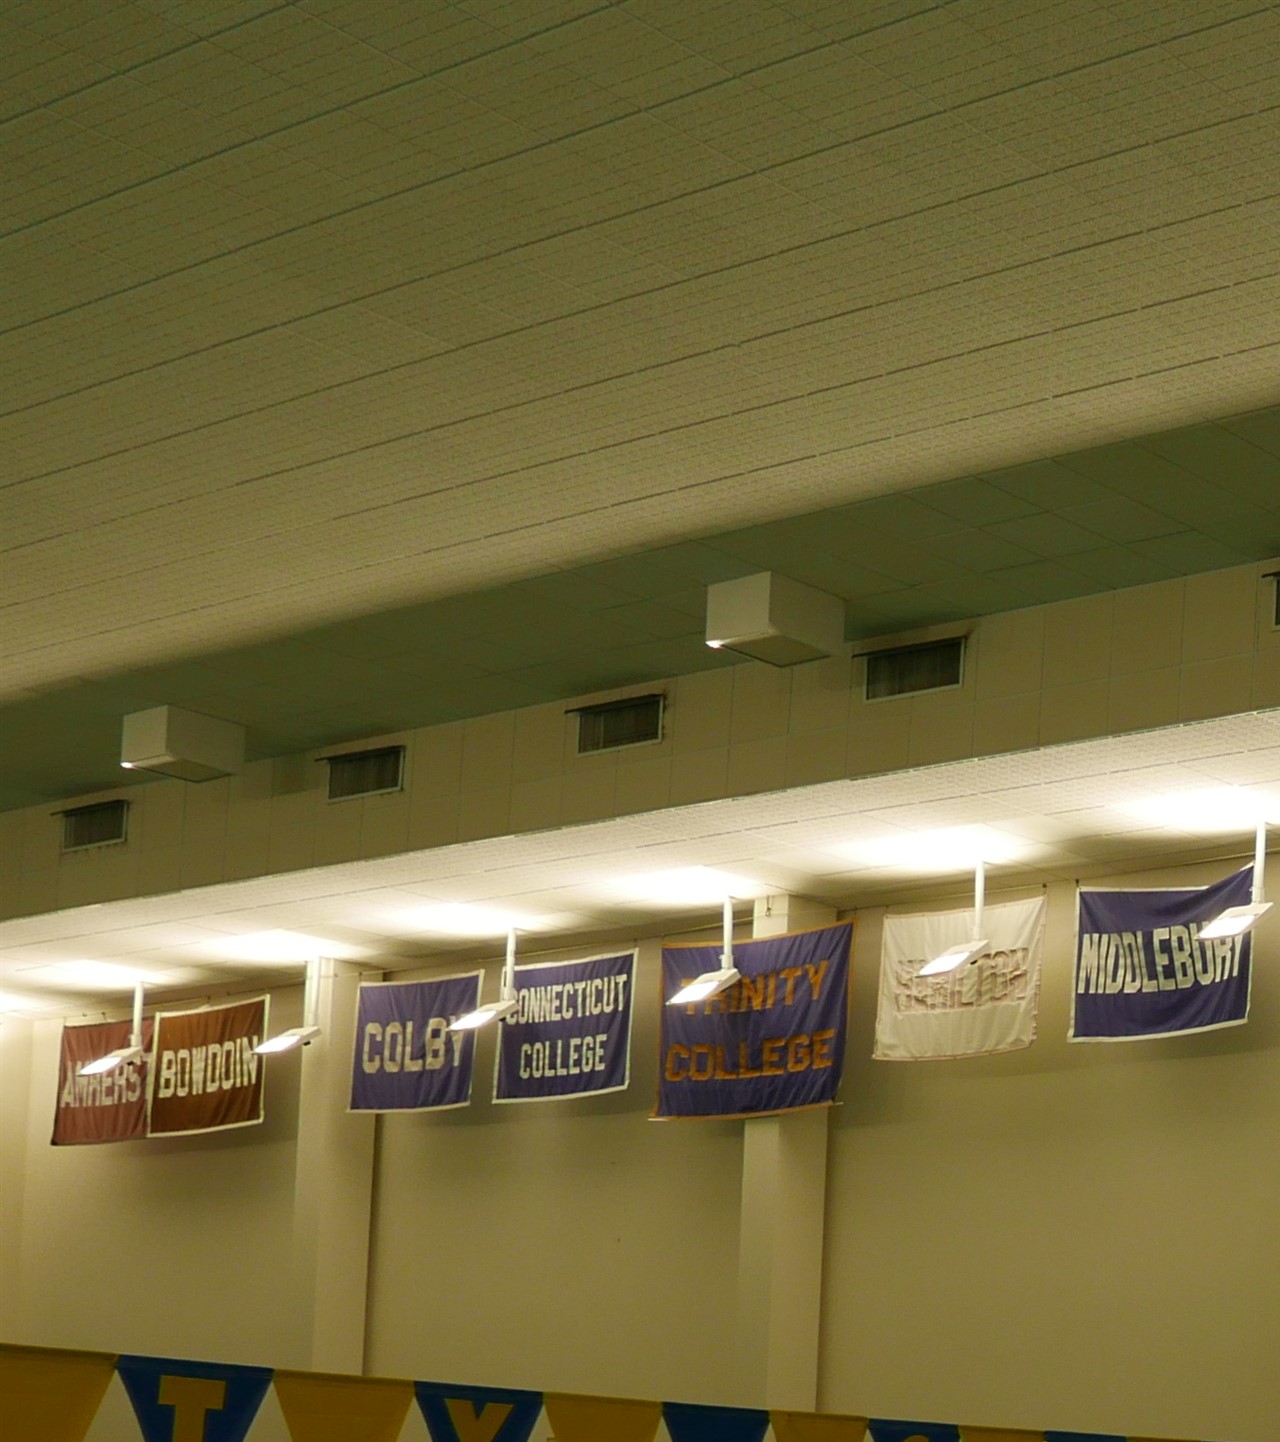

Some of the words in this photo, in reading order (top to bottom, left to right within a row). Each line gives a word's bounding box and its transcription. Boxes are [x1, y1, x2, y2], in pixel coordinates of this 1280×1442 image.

[1076, 921, 1246, 994] MIDDLEBURY
[506, 974, 628, 1026] CONNECTICUT
[682, 960, 827, 1016] TRINITY
[158, 1037, 258, 1099] BOWDOIN
[362, 1014, 464, 1074] COLBY
[519, 1034, 608, 1080] COLLEGE
[665, 1030, 835, 1082] COLLEGE
